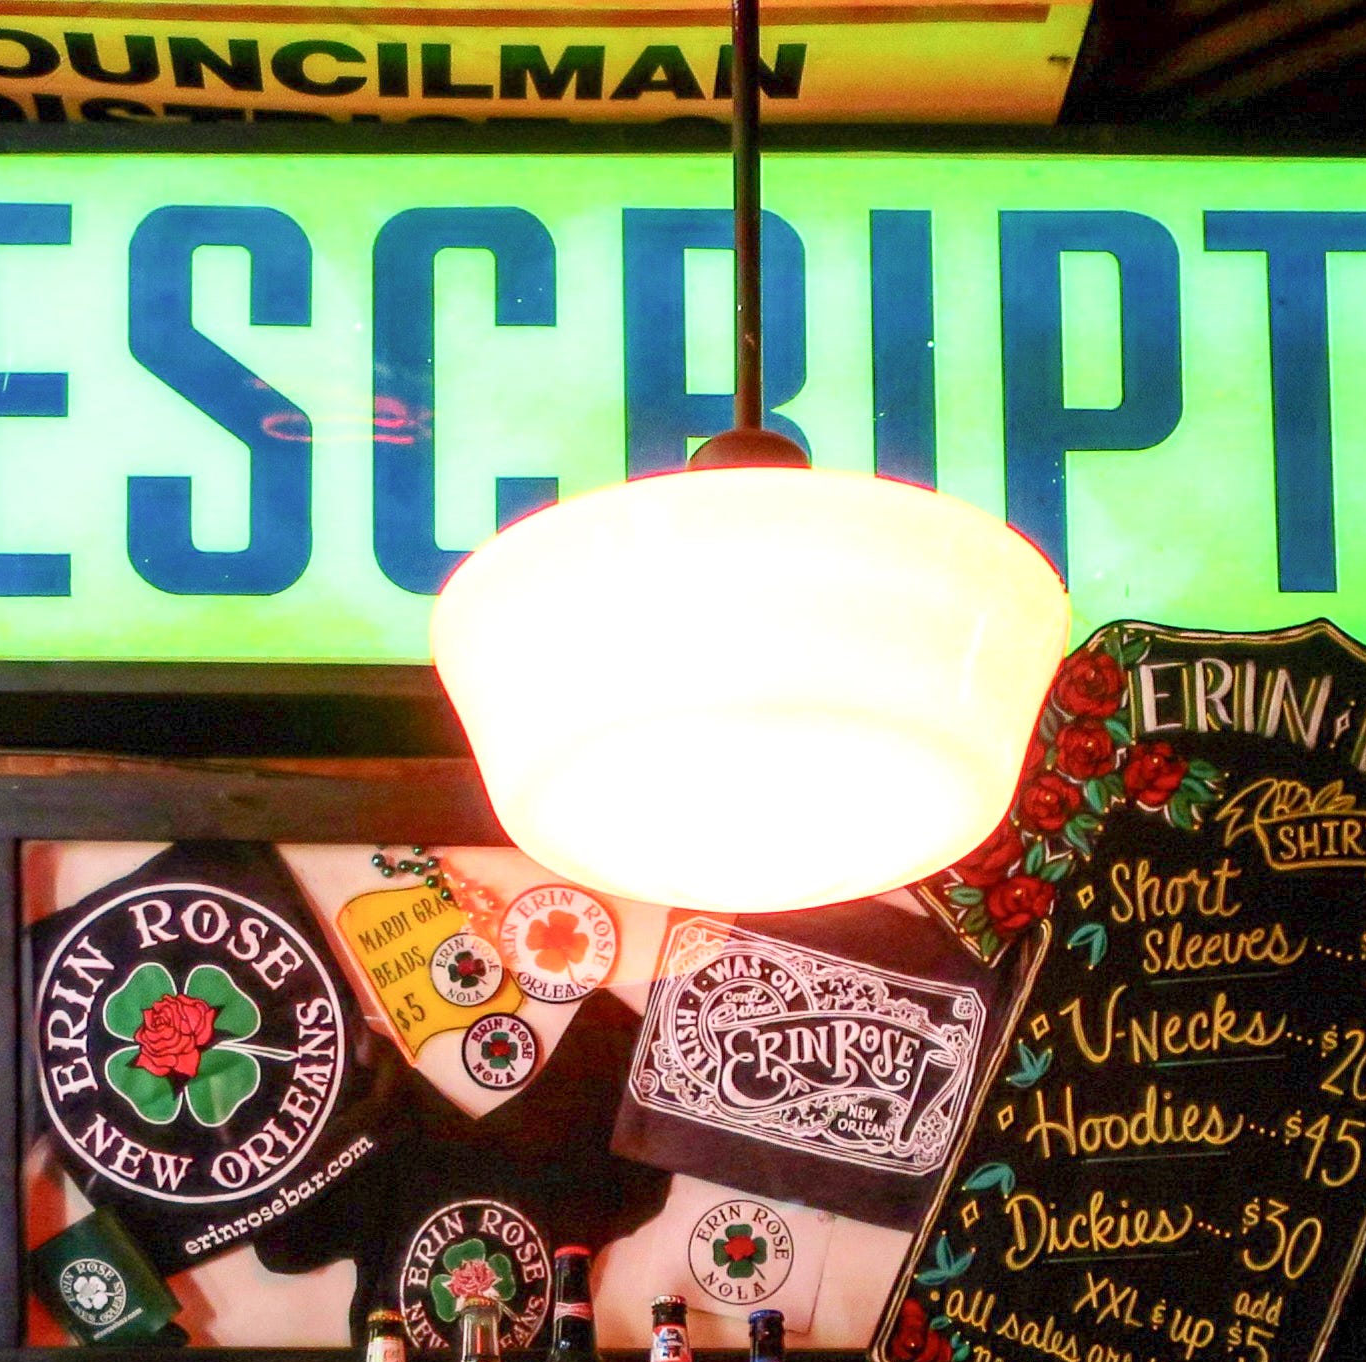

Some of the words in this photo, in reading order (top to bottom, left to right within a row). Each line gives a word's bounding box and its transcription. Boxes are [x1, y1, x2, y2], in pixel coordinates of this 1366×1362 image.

[1135, 657, 1334, 751] ERIN
[1109, 858, 1243, 924] Short
[358, 909, 413, 955] MARDI
[436, 937, 467, 970] ERIN
[518, 891, 575, 918] ERIN
[583, 904, 612, 969] ROSE
[371, 945, 428, 990] BEADS
[445, 986, 486, 1004] NOLA
[48, 936, 115, 1102] ERIN
[128, 898, 303, 990] ROSE
[395, 993, 427, 1033] $5
[677, 1008, 720, 1084] IRISH
[706, 957, 765, 986] WAS
[770, 970, 802, 1003] ON
[1059, 983, 1288, 1067] V-Necks
[471, 1017, 504, 1044] ERIN
[76, 1113, 193, 1193] NEW
[210, 998, 335, 1190] ORLEANS
[473, 1062, 517, 1086] NOLA
[837, 1118, 897, 1144] ORLEANS
[847, 1103, 878, 1122] NEW
[1025, 1083, 1245, 1160] Hoodies
[1284, 1110, 1366, 1188] $45
[184, 1135, 374, 1256] erinrosebar.com
[406, 1212, 466, 1288] ERIN
[480, 1207, 548, 1286] ROSE
[696, 1203, 743, 1244] ERIN
[753, 1206, 791, 1263] ROSE
[1005, 1190, 1195, 1272] Dickies
[1241, 1197, 1324, 1281] $30
[703, 1270, 767, 1300] NOLA
[1073, 1271, 1144, 1328] XXL
[1234, 1291, 1283, 1328] add
